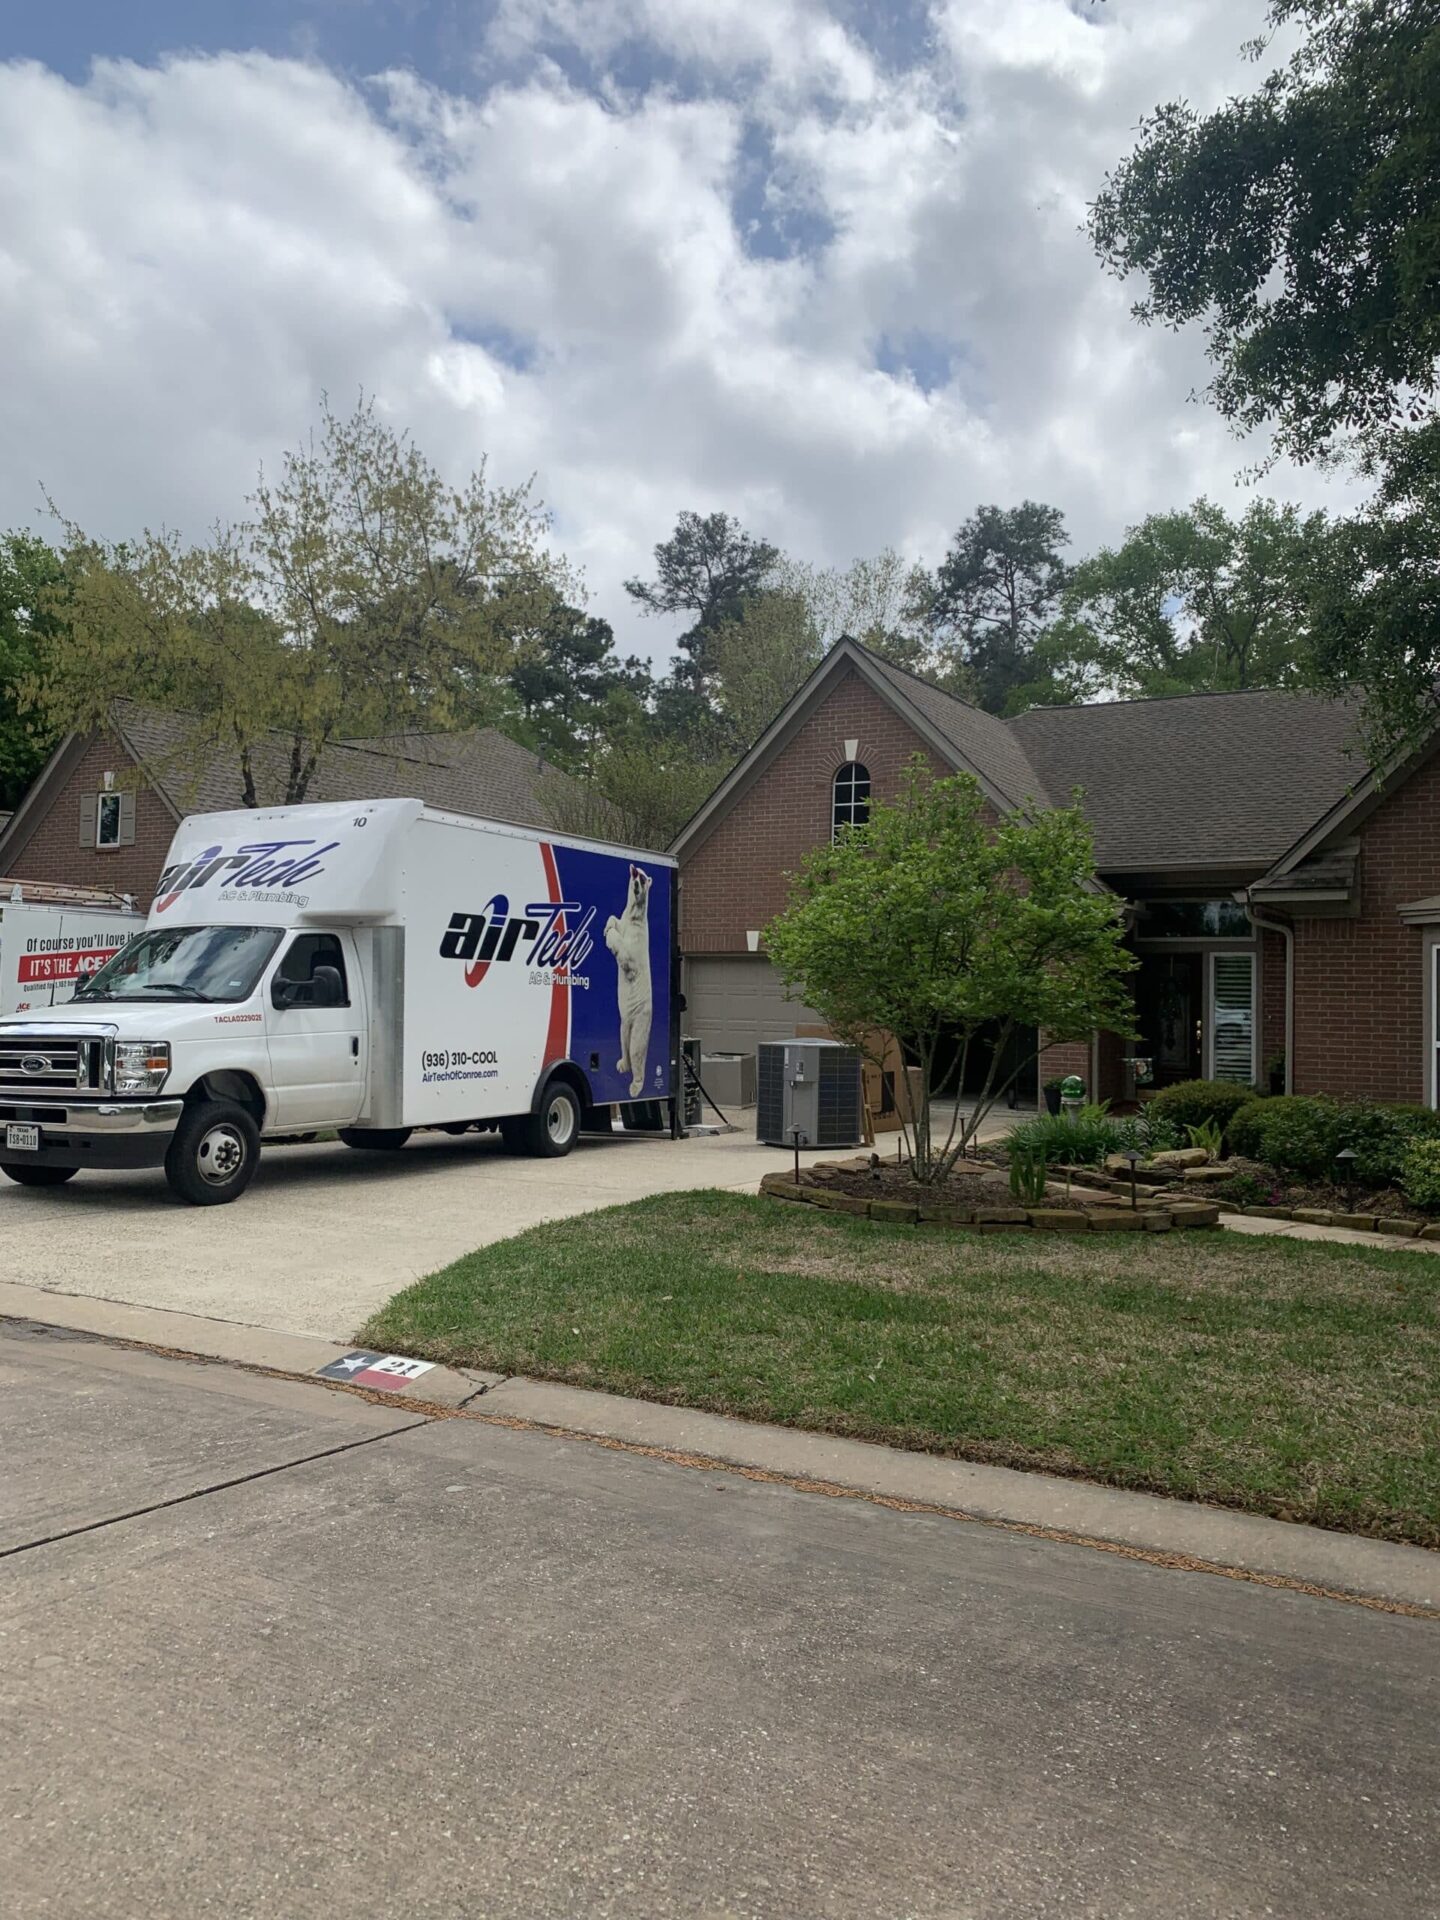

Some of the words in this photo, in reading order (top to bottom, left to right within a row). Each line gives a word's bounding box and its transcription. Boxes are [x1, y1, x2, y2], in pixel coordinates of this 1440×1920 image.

[353, 817, 367, 827] 10
[219, 891, 237, 901] AC
[239, 891, 249, 901] &
[249, 892, 310, 908] Plumbing
[27, 938, 38, 952] Of
[40, 937, 74, 952] course
[76, 934, 104, 951] you'll
[106, 933, 125, 947] love
[30, 960, 51, 976] IT'S
[53, 958, 72, 974] THE
[74, 954, 104, 973] ACE
[529, 971, 543, 985] AC
[551, 972, 590, 989] Plumbing
[422, 1050, 449, 1071] (936)
[451, 1051, 498, 1066] 310-COOL
[422, 1070, 498, 1083] AirTechOfConroe.com
